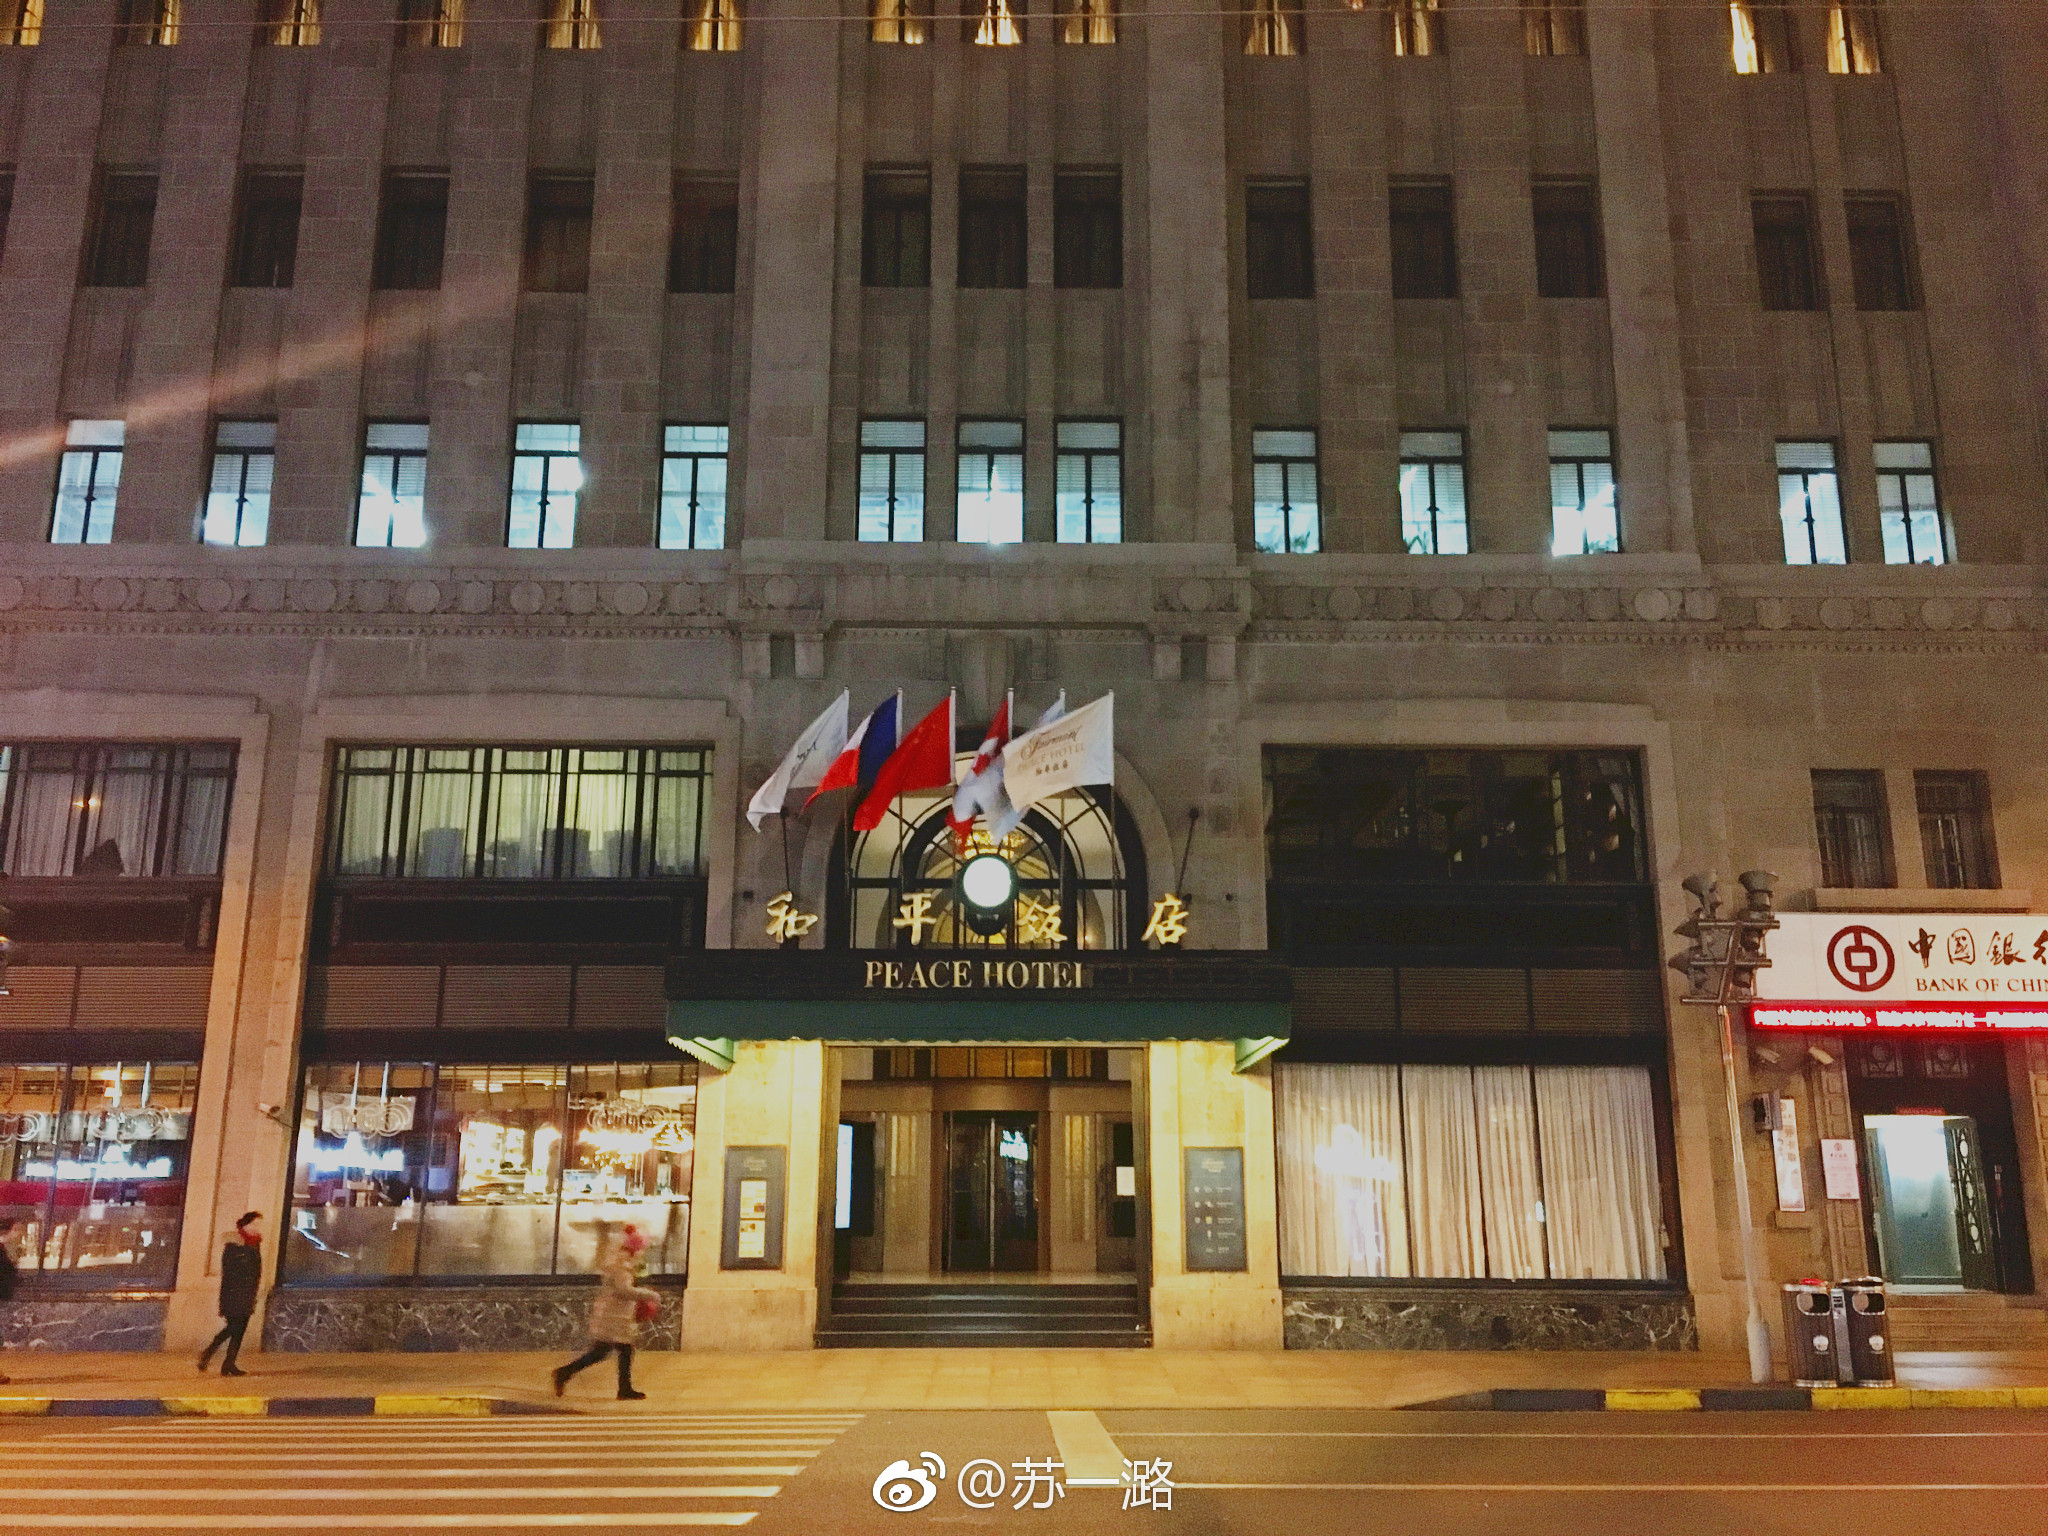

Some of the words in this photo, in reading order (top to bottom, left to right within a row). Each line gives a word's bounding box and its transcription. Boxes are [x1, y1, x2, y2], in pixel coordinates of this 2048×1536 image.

[864, 960, 972, 989] PEACE
[1916, 978, 1969, 992] BANK
[1975, 978, 2000, 992] OF
